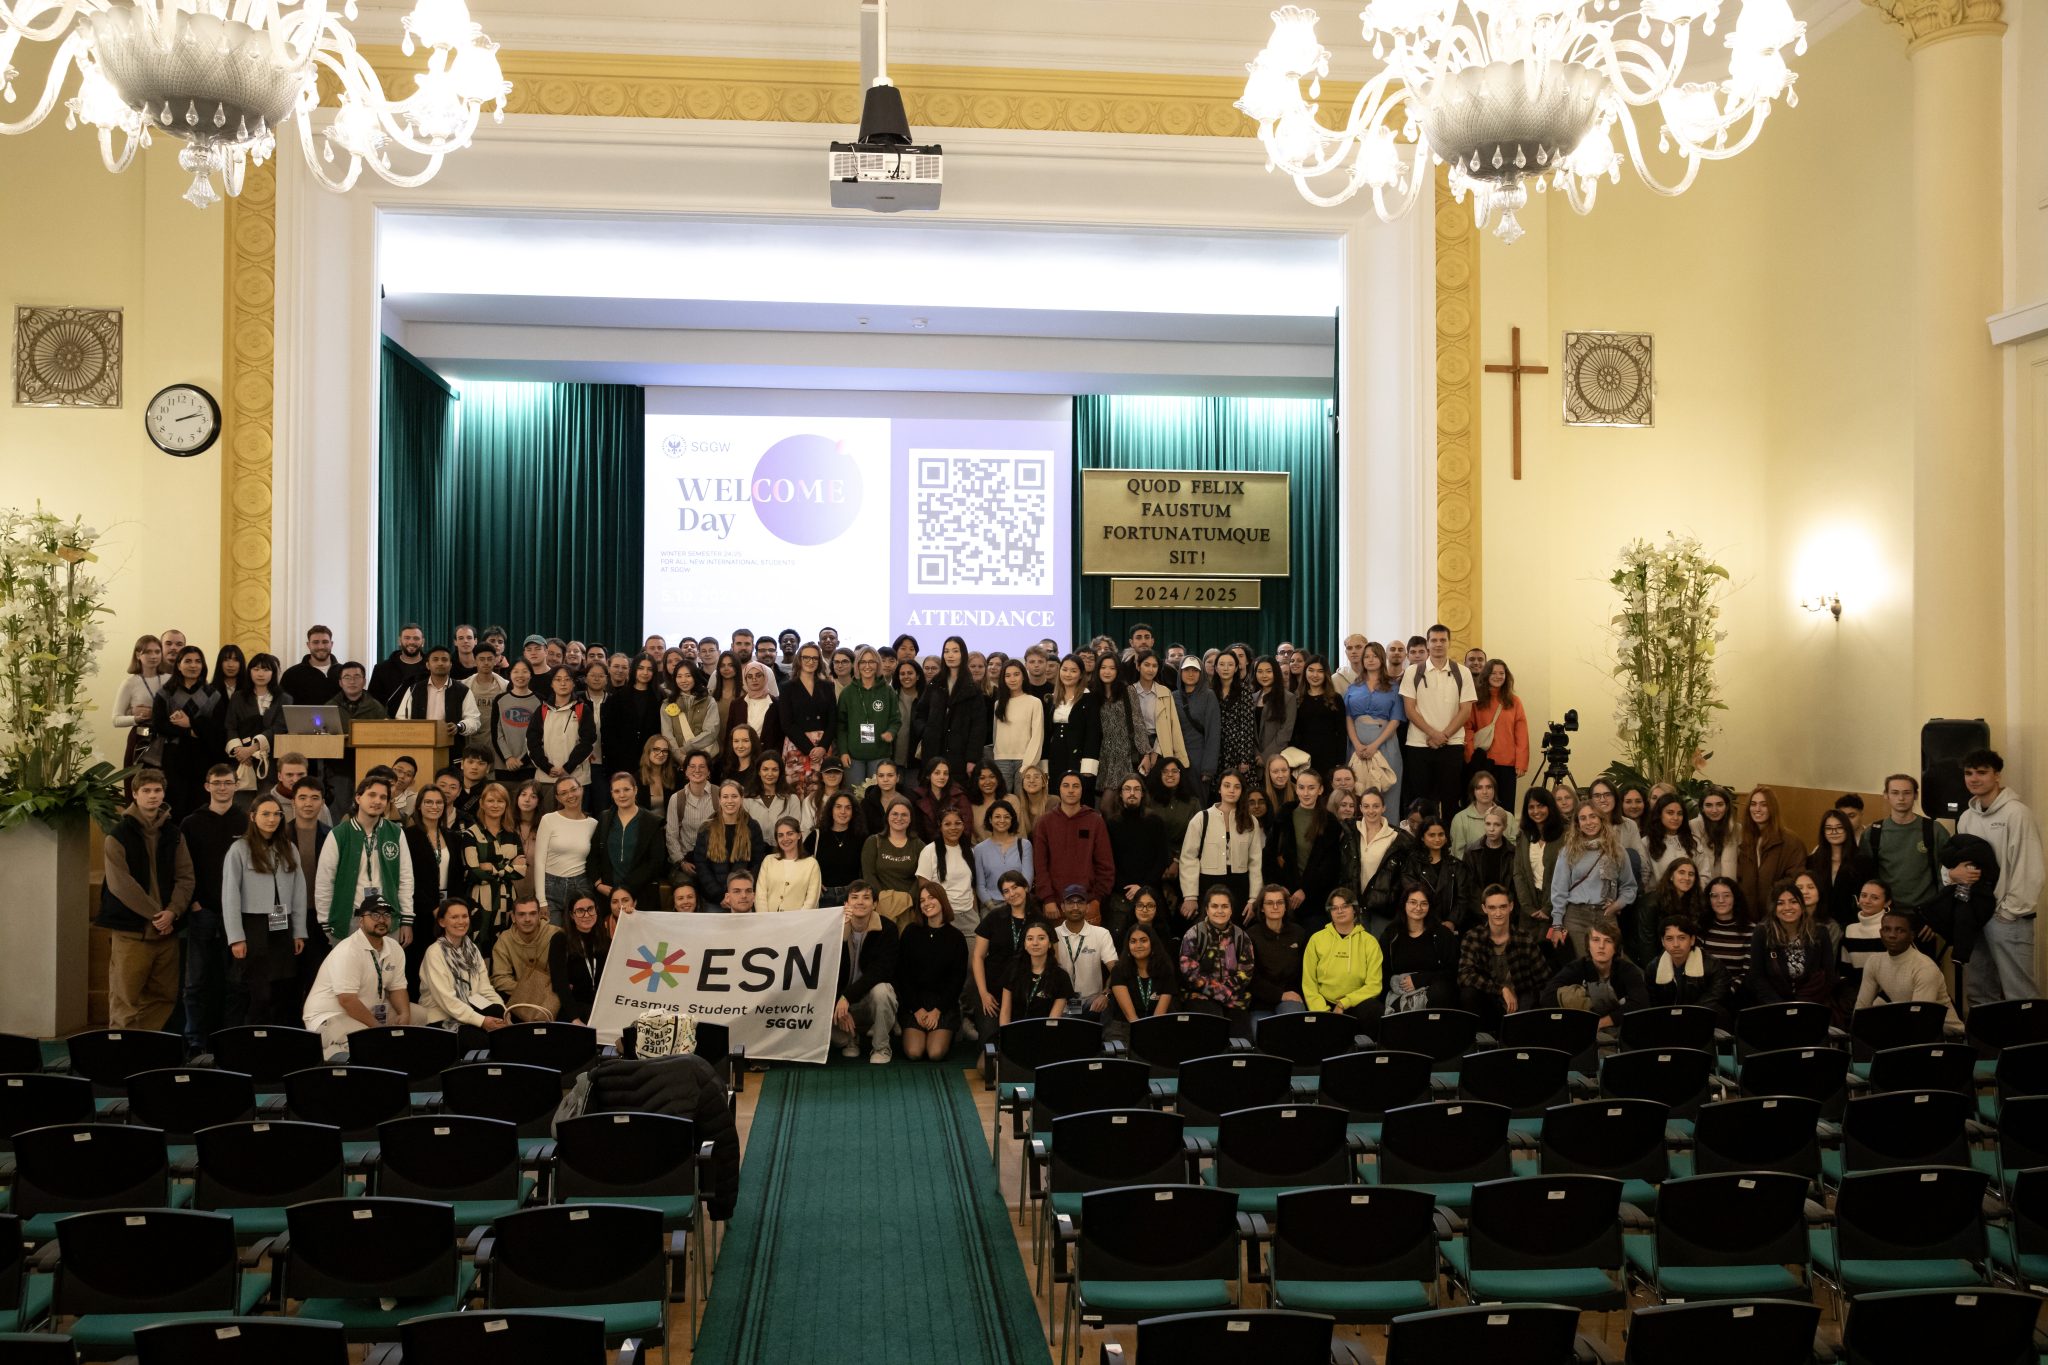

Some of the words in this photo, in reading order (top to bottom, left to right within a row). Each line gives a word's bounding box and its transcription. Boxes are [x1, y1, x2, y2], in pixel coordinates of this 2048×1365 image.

[691, 441, 730, 453] SGGW
[677, 477, 846, 504] WELCOME
[1127, 478, 1181, 495] QUOD
[1191, 480, 1245, 495] FELIX
[1141, 503, 1232, 518] FAUSTUM
[677, 507, 737, 540] Day
[1103, 526, 1271, 544] FORTUNATUMQUE
[1169, 551, 1205, 565] SIT!
[907, 609, 1056, 627] ATTENDANCE
[696, 943, 823, 993] ESN
[615, 995, 680, 1012] Erasmus
[688, 1003, 748, 1016] Student
[755, 1003, 815, 1016] Network
[765, 1018, 813, 1030] SGGW
